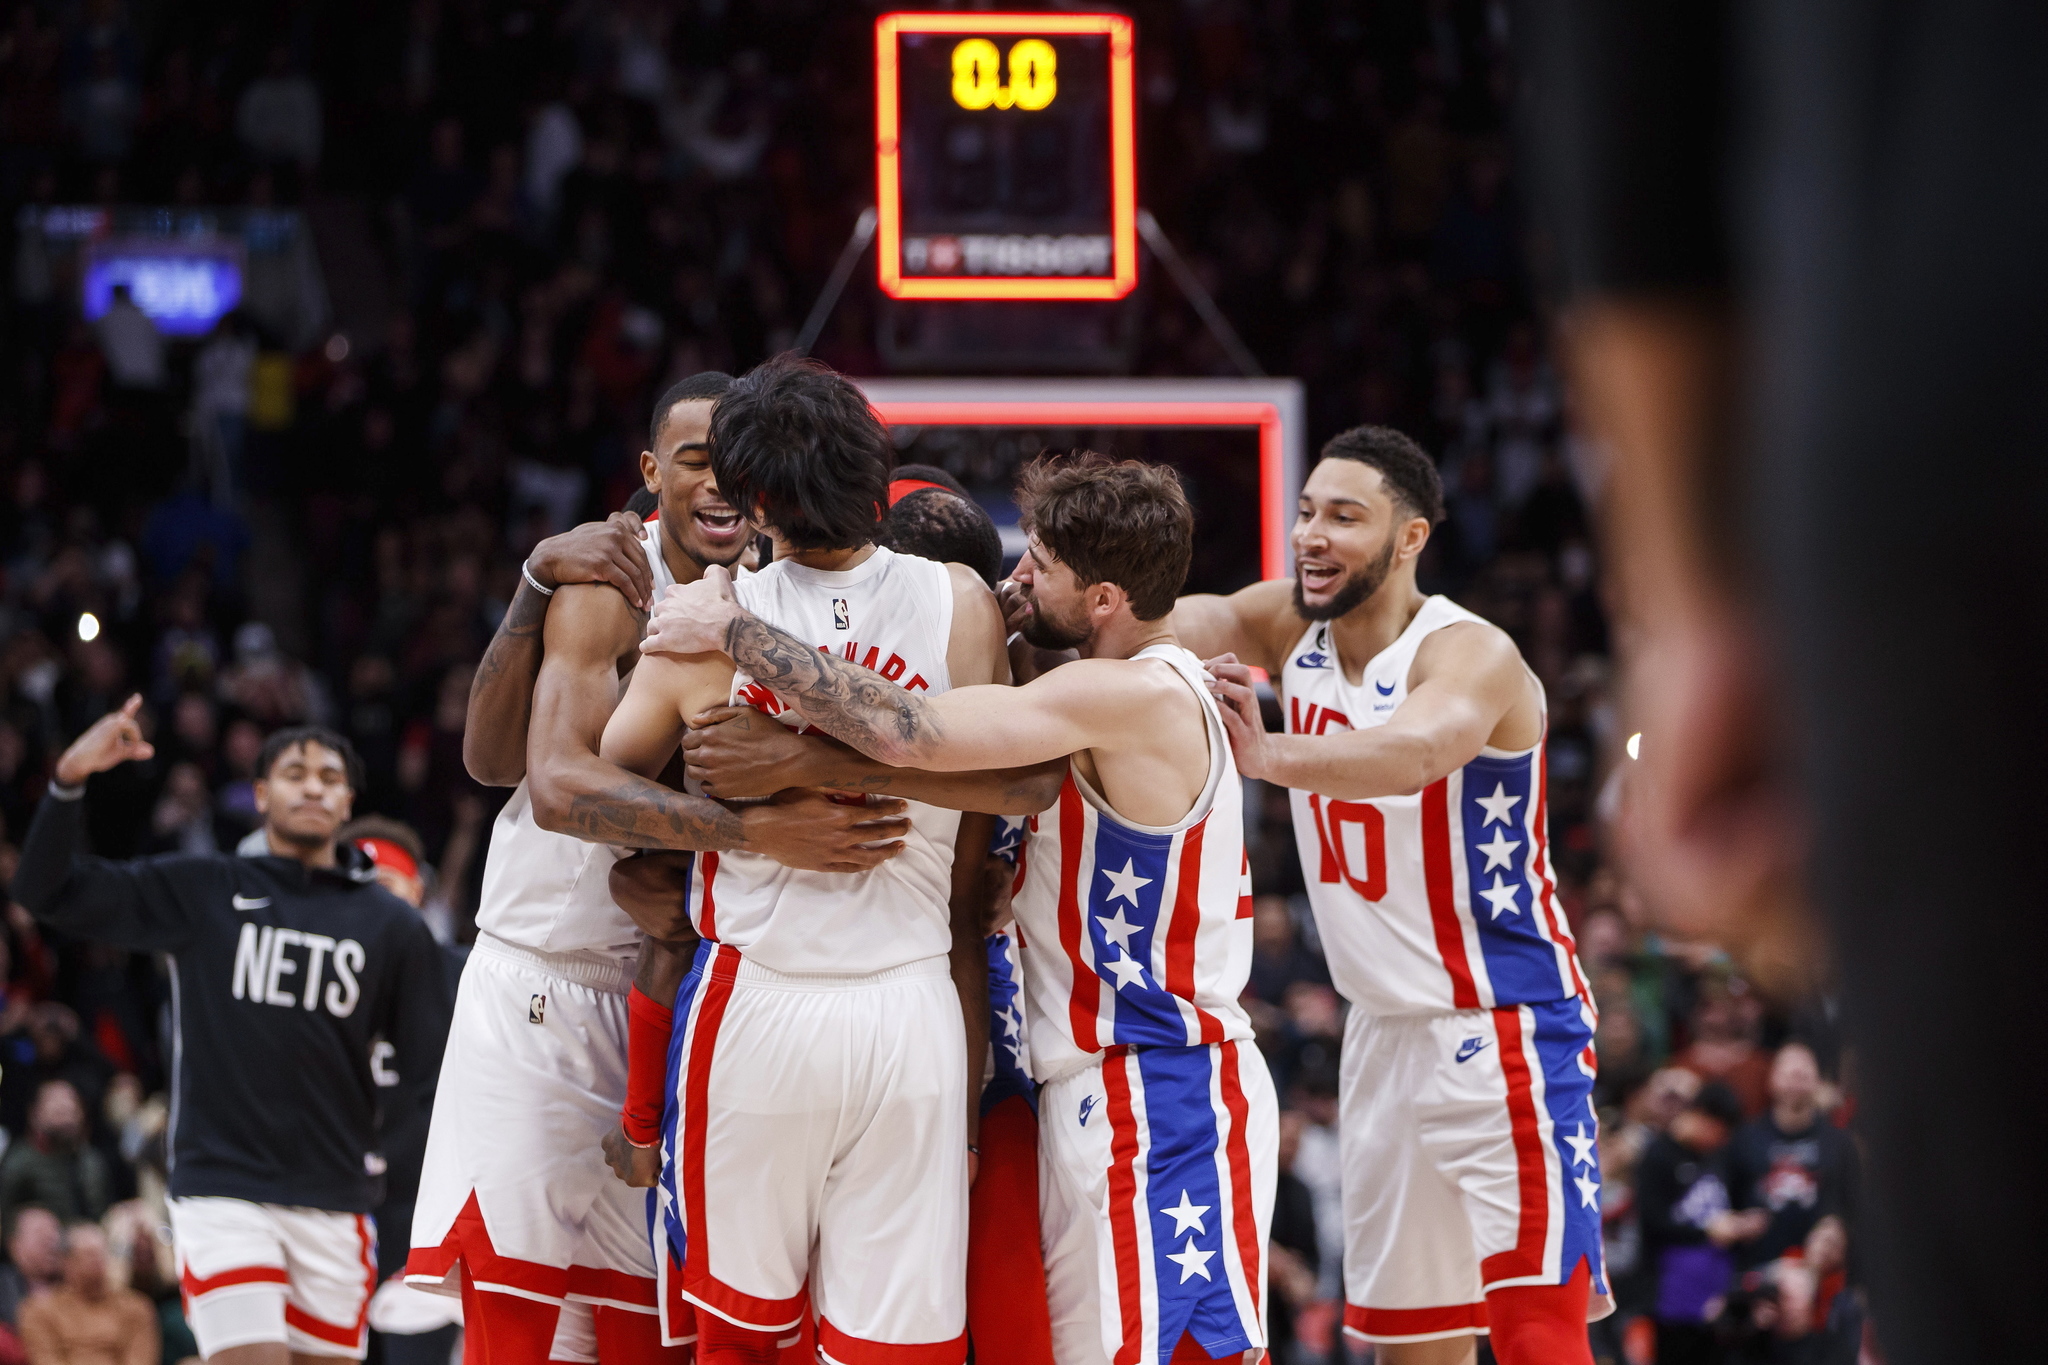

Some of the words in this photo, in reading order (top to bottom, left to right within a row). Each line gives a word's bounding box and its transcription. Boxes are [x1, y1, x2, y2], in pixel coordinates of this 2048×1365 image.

[951, 38, 1057, 111] 0.0
[1309, 794, 1388, 902] 10
[232, 921, 366, 1018] NETS
